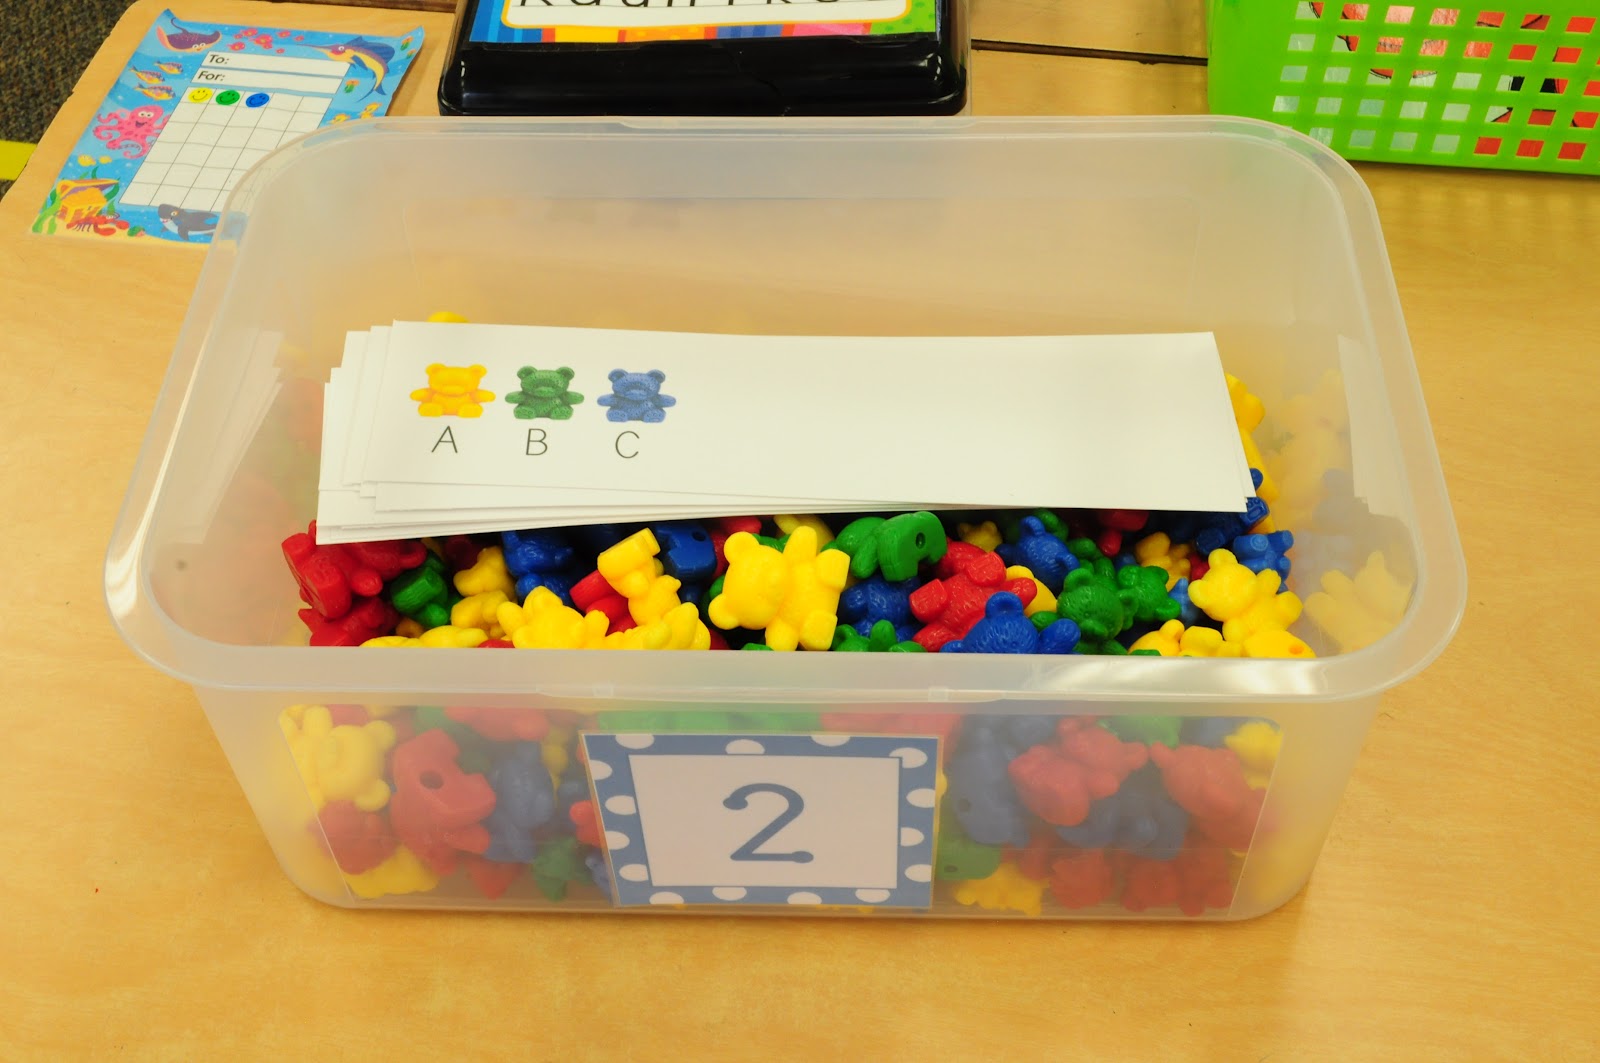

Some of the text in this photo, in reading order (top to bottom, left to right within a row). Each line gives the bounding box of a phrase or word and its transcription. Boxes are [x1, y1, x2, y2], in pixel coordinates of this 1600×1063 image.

[209, 54, 230, 64] To:
[197, 70, 226, 82] For:
[431, 425, 640, 459] A B C
[722, 782, 815, 864] 2
